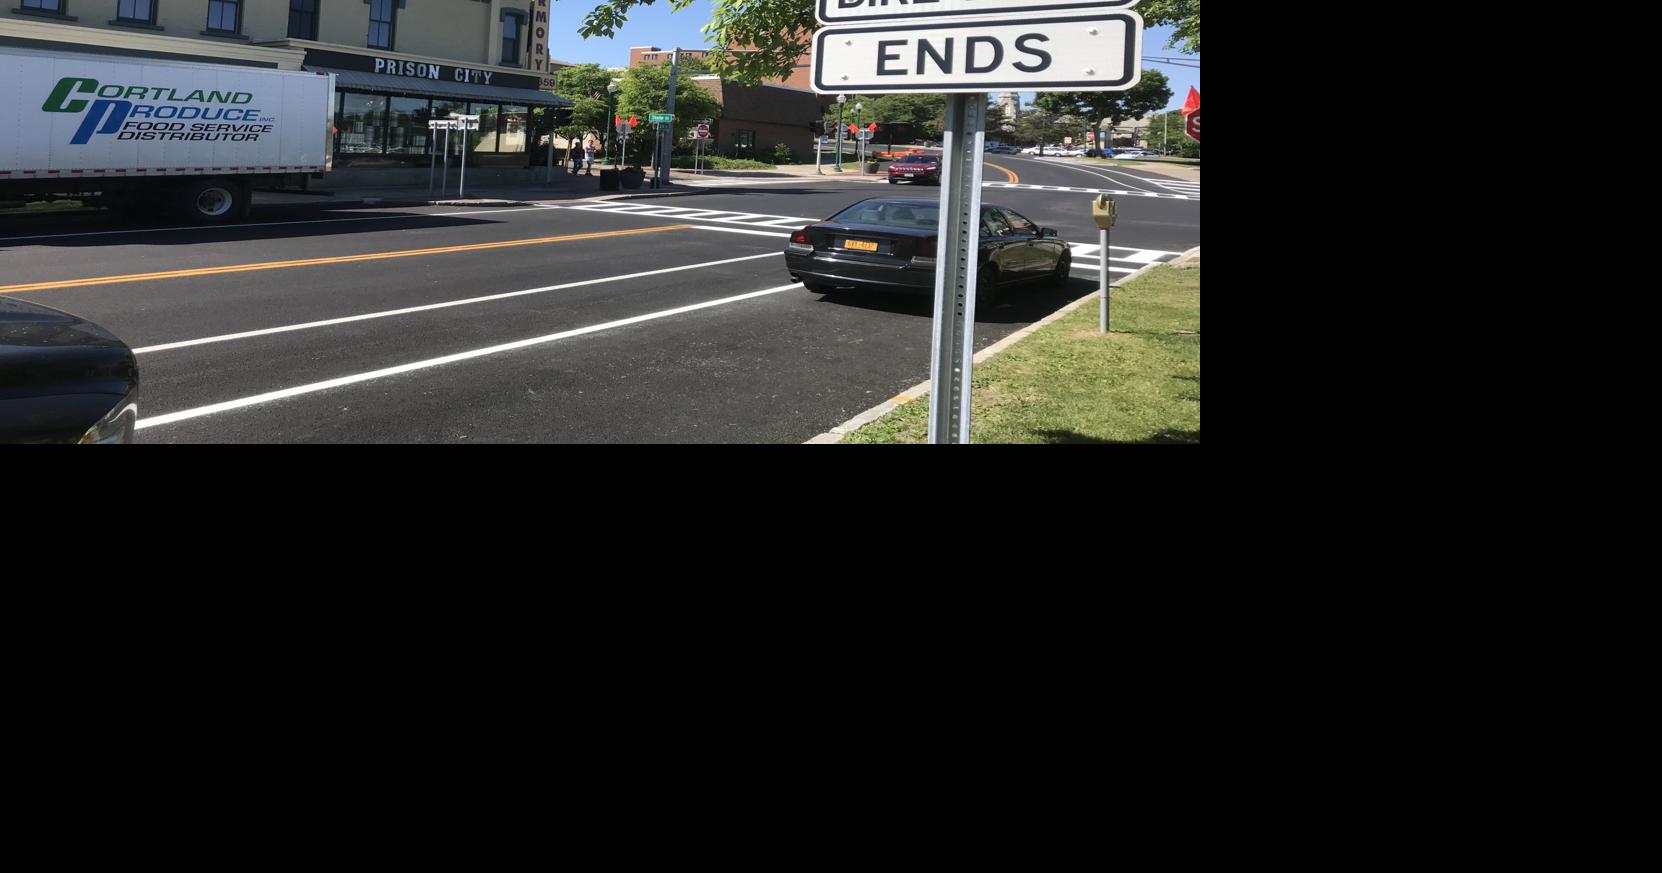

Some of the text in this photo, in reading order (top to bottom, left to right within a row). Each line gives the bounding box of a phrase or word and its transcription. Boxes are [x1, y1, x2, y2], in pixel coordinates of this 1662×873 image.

[876, 32, 1052, 76] ENDS
[374, 58, 494, 85] PRISON CITY
[42, 77, 254, 113] CORTLAND
[69, 99, 262, 145] PRODUCE
[117, 131, 260, 142] DISTRIBUTOR
[122, 121, 274, 133] FOOD SERVICE
